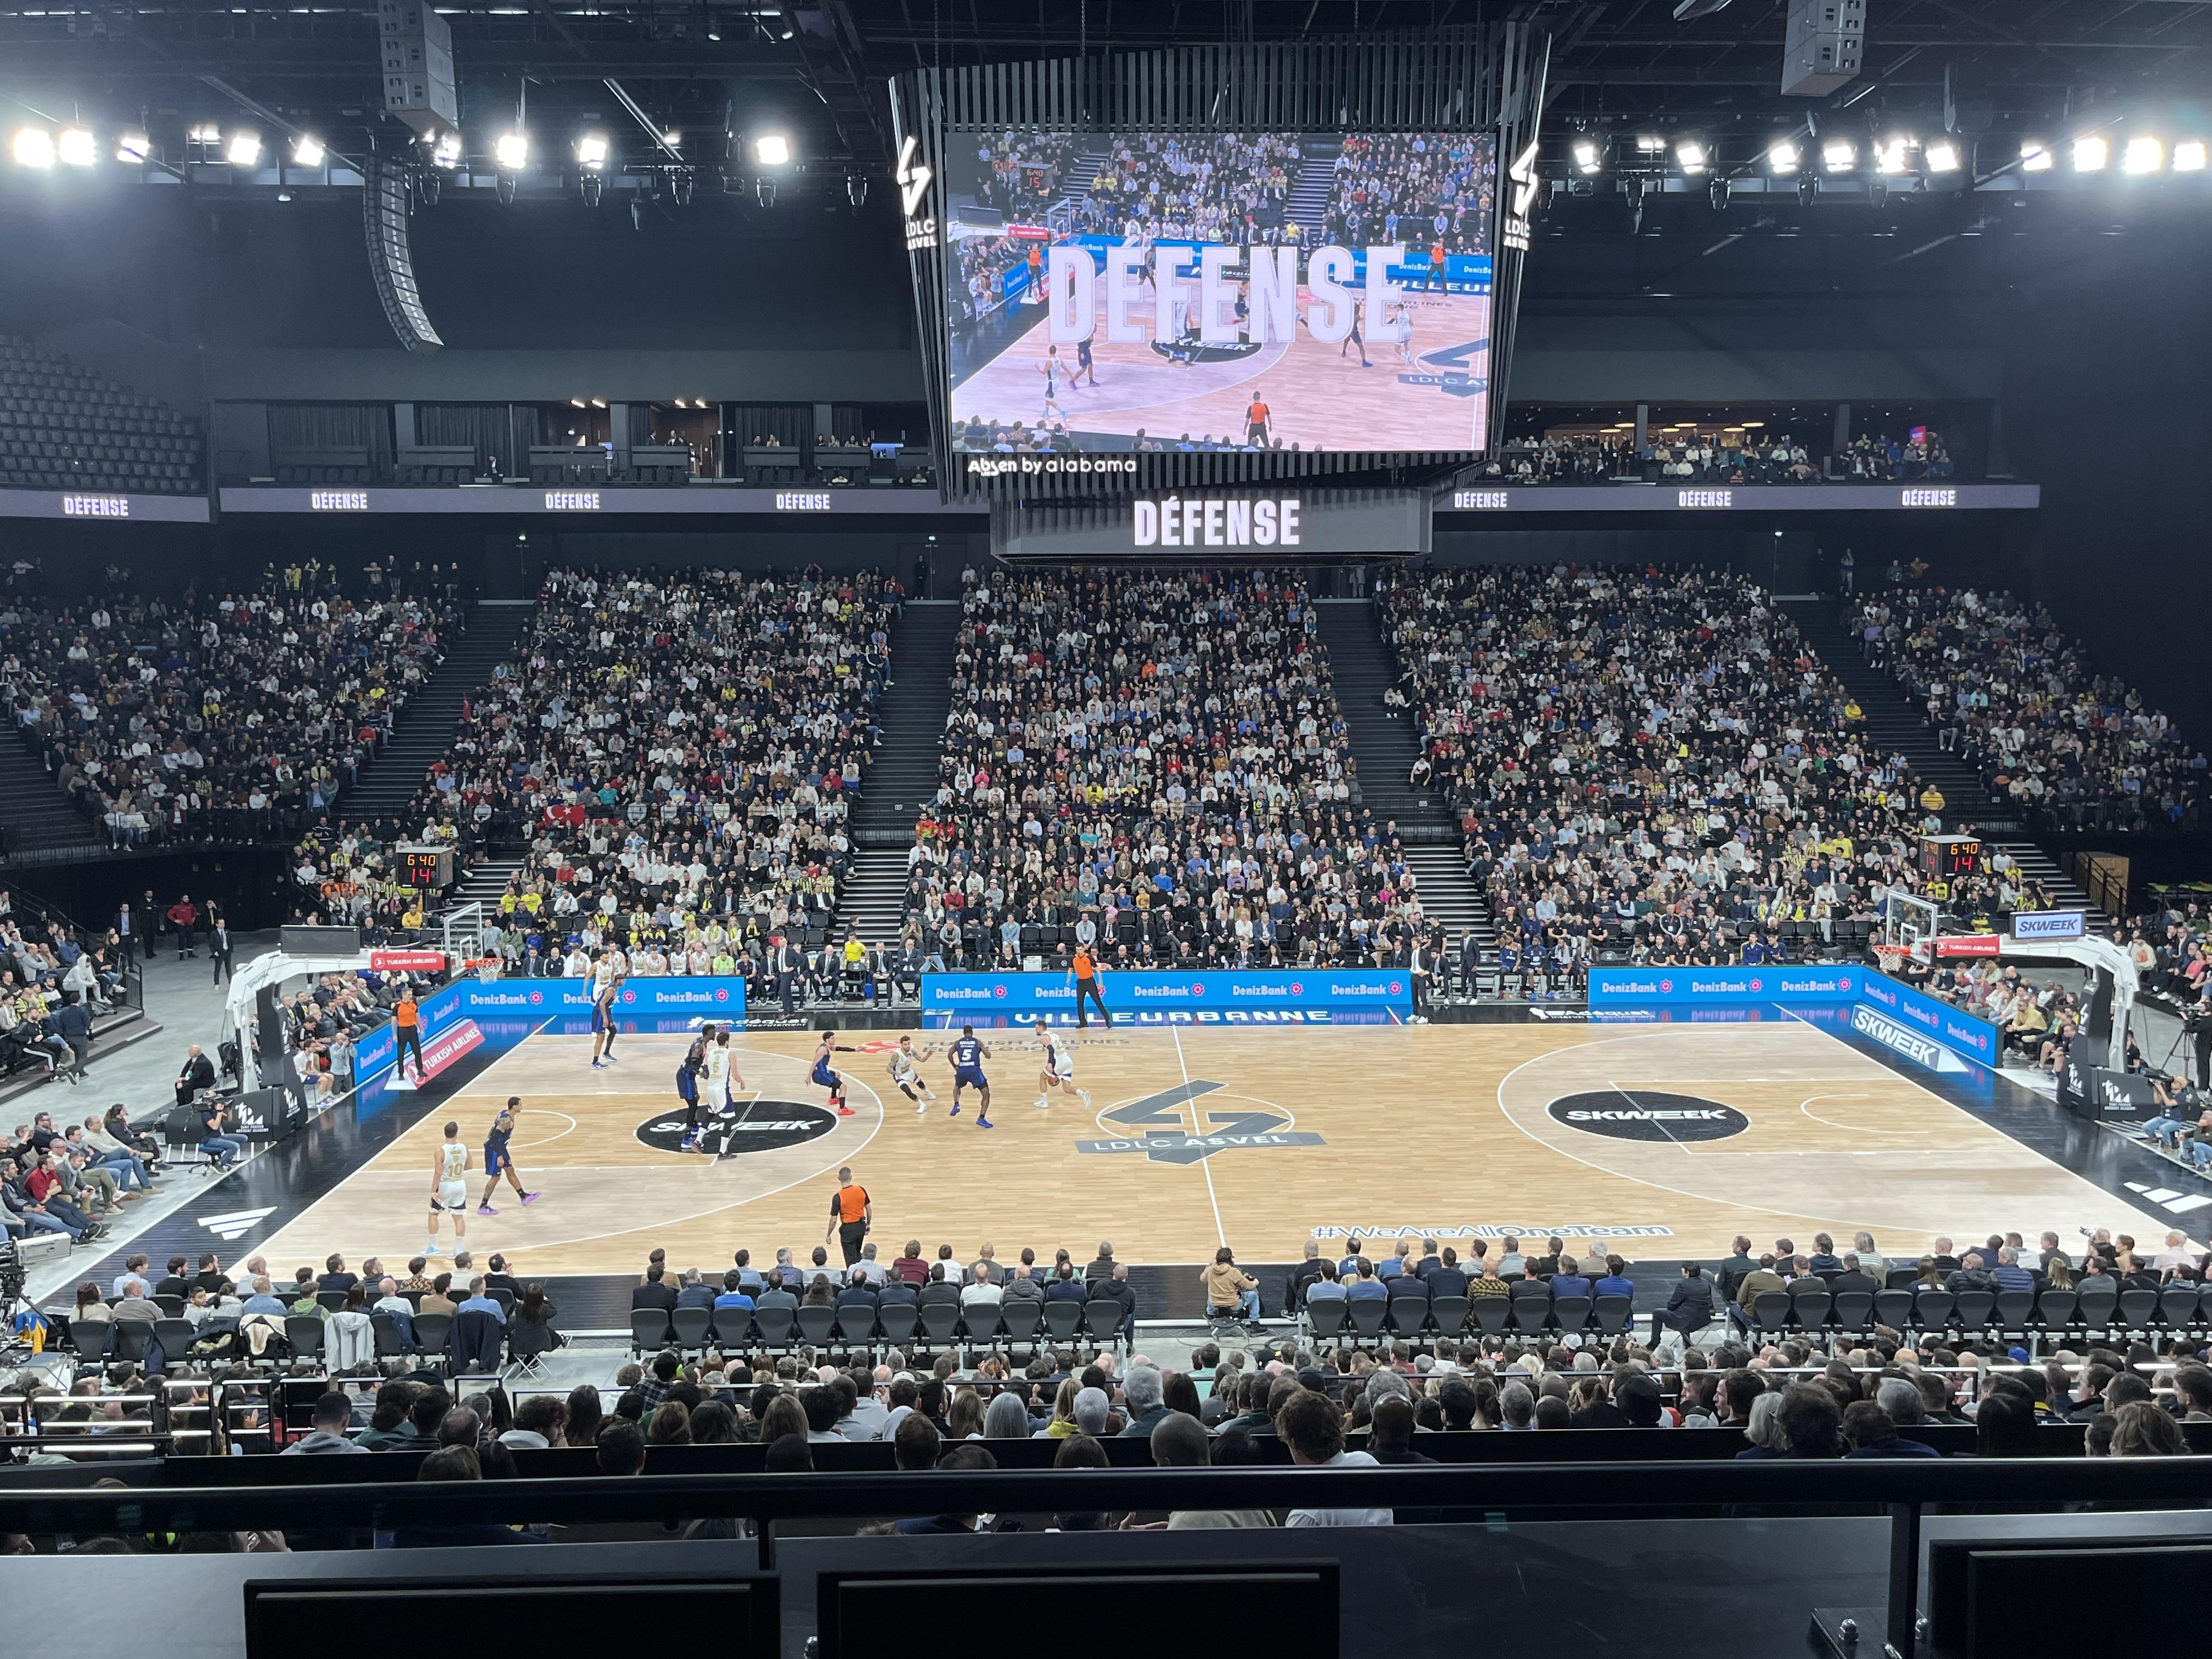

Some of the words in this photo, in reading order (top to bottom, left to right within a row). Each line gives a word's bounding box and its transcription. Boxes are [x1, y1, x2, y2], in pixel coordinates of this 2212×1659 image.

[906, 219, 935, 238] LDLC
[1505, 218, 1531, 238] LDLC
[907, 235, 937, 251] ASVEL
[1409, 376, 1458, 384] LDLC
[967, 458, 1017, 476] Absen
[1022, 457, 1042, 475] by
[1045, 458, 1136, 473] alabama
[64, 495, 129, 516] DÉFENSE
[311, 492, 368, 509] DÉFENSE
[545, 492, 600, 509] DÉFENSE
[776, 492, 830, 510] DÉFENSE
[1454, 491, 1507, 509] DÉFENSE
[1678, 490, 1732, 507] DÉFENSE
[1901, 489, 1956, 506] DÉFENSE
[1134, 495, 1300, 546] DÉFENSE
[1955, 855, 1973, 872] 14
[411, 868, 431, 883] 14
[2019, 918, 2078, 932] SKWEEK
[936, 989, 991, 998] DenizBank
[1036, 988, 1077, 998] DenizBa
[1135, 986, 1189, 996] DenizBank
[1233, 985, 1287, 996] DenizBank
[1332, 985, 1386, 995] DenizBank
[1602, 982, 1656, 992] DenizBank
[1692, 981, 1746, 992] DenizBank
[1781, 981, 1836, 991] DenizBank
[1865, 983, 1888, 1004] DenizBank
[470, 994, 527, 1005] DenizBank
[656, 991, 713, 1002] DenizBank
[434, 1001, 454, 1022] DenizBank
[1904, 1002, 1931, 1024] DenizBank
[1854, 1011, 1937, 1065] SKWEEK
[1948, 1023, 1977, 1047] DenizBank
[360, 1044, 386, 1069] DenizBank
[424, 1045, 453, 1070] TURKISH
[452, 1026, 481, 1051] AIRLINES
[961, 1048, 972, 1060] 5
[1566, 1109, 1727, 1120] SKWEEK
[1093, 1139, 1172, 1150] LDLC
[1184, 1135, 1289, 1147] ASVEL
[448, 1163, 464, 1177] 10
